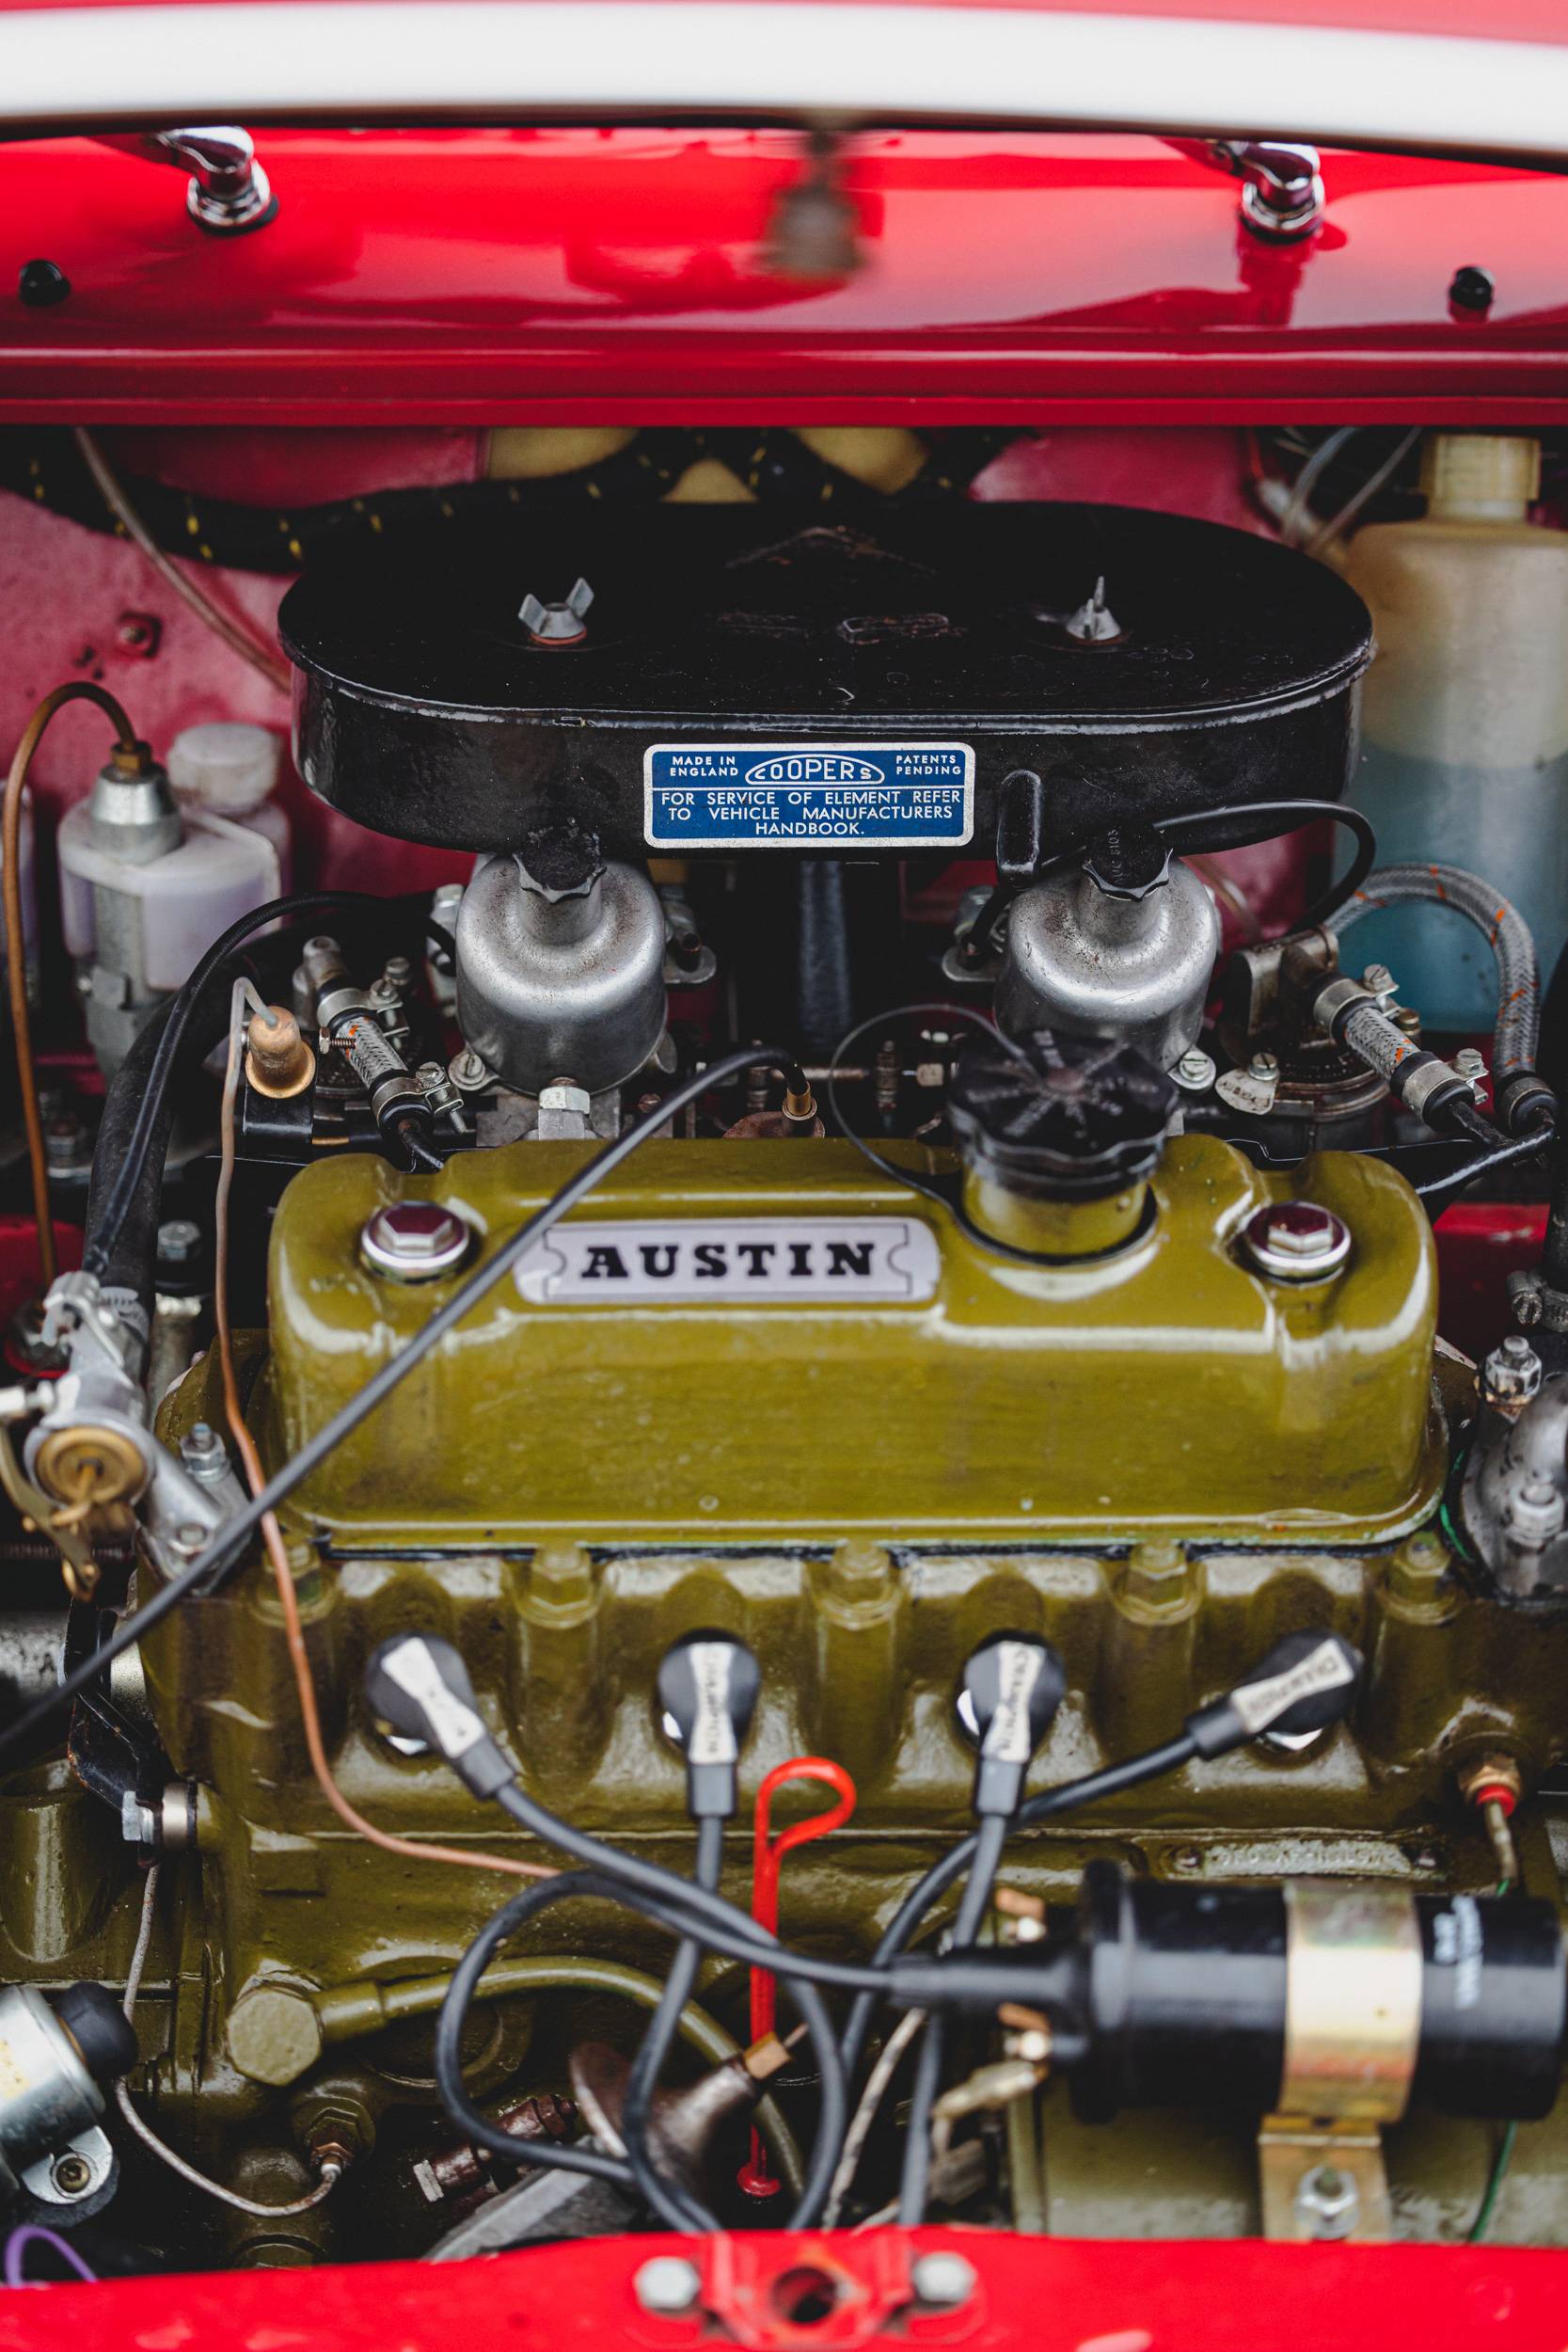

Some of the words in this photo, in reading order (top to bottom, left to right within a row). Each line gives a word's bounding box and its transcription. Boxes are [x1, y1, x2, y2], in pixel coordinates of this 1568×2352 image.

[673, 756, 711, 765] MADE
[721, 756, 735, 765] IN
[671, 768, 737, 776] ENGLAND
[662, 793, 694, 804] FOR
[707, 792, 774, 804] SERVICE
[788, 792, 812, 804] OF
[826, 791, 900, 803] ELEMENT
[913, 790, 959, 803] REFER
[669, 808, 690, 820] TO
[709, 807, 779, 819] VEHICLE
[803, 806, 952, 819] MANUFACTURERS
[756, 822, 863, 834] HANDBOOK.
[582, 1244, 874, 1278] AUSTIN
